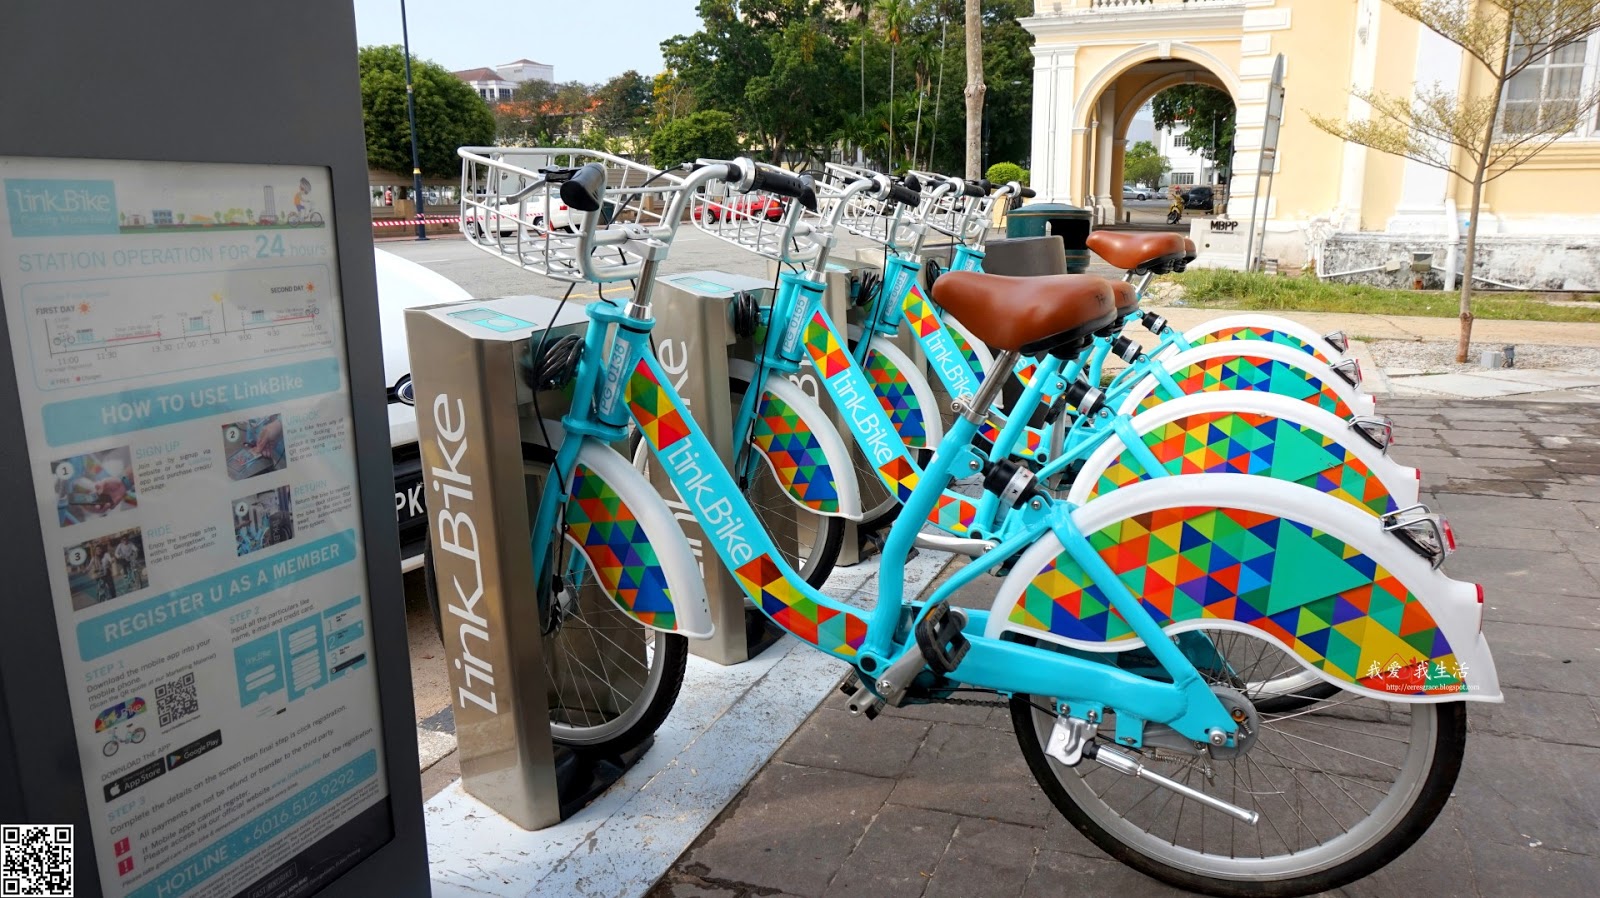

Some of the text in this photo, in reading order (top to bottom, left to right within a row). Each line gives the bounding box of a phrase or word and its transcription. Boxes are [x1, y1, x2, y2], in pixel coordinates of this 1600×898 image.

[1211, 220, 1239, 231] MBPP
[18, 234, 327, 273] STATION OPERATION FOR 24 hours
[270, 286, 293, 294] SECOND
[35, 304, 76, 316] FIRST DAY
[783, 332, 794, 349] PG
[600, 343, 625, 411] PG 0138
[101, 375, 304, 425] HOW TO USE LinkBike
[229, 429, 236, 440] 2
[136, 440, 180, 460] SIGN UP
[62, 466, 68, 476] 1
[166, 469, 192, 480] purchase
[238, 504, 245, 514] 4
[147, 523, 173, 538] RIDE
[148, 541, 164, 550] Enjoy
[203, 525, 216, 533] sites
[173, 537, 205, 550] Georgetown
[74, 552, 81, 562] 3
[171, 551, 183, 560] your
[104, 543, 340, 642] REGISTER U AS A MEMBER
[229, 605, 261, 624] STEP 2
[230, 624, 247, 634] Input
[248, 619, 256, 627] all
[257, 615, 267, 624] the
[268, 603, 299, 620] particulars
[231, 632, 251, 643] name,
[252, 624, 271, 634] e-mail
[271, 617, 283, 626] and
[284, 610, 300, 620] credit
[329, 635, 336, 649] 2
[87, 639, 211, 693] Download the mobile app into your
[331, 652, 338, 664] 3
[85, 660, 125, 682] STEP 1
[88, 676, 142, 702] mobile phone.
[89, 699, 108, 712] (Scan
[109, 692, 119, 701] the
[120, 688, 129, 698] QR
[165, 663, 193, 678] Marketing
[183, 739, 219, 759] Google Play
[101, 757, 142, 781] DOWNLOAD
[143, 749, 157, 761] THE
[158, 742, 172, 754] APP
[110, 810, 150, 835] Complete
[152, 802, 166, 814] the
[166, 787, 193, 805] details
[193, 781, 204, 791] on
[205, 773, 217, 785] the
[218, 761, 242, 778] screen
[243, 751, 258, 765] then
[259, 743, 274, 756] final
[275, 735, 290, 748] step
[296, 723, 312, 736] click
[312, 704, 349, 727] registration.
[124, 778, 140, 793] App
[141, 768, 161, 782] Store
[139, 828, 150, 841] All
[151, 810, 189, 835] payments
[190, 803, 202, 814] are
[203, 794, 215, 806] not
[216, 788, 226, 798] be
[226, 775, 249, 792] refund
[250, 770, 258, 779] or
[258, 756, 283, 774] transfer
[292, 745, 302, 756] the
[303, 737, 317, 749] third
[143, 845, 169, 863] Please
[170, 830, 196, 848] access
[196, 822, 208, 833] via
[208, 815, 221, 825] our
[221, 801, 245, 818] official
[246, 786, 271, 802] website
[322, 751, 331, 760] for
[332, 745, 342, 754] the
[342, 728, 374, 748] registration
[107, 799, 136, 822] STEP
[151, 831, 177, 849] Mobile
[178, 819, 197, 834] apps
[197, 804, 222, 822] cannot
[223, 790, 250, 809] register.
[156, 858, 170, 870] good
[157, 845, 229, 898] HOTLINE
